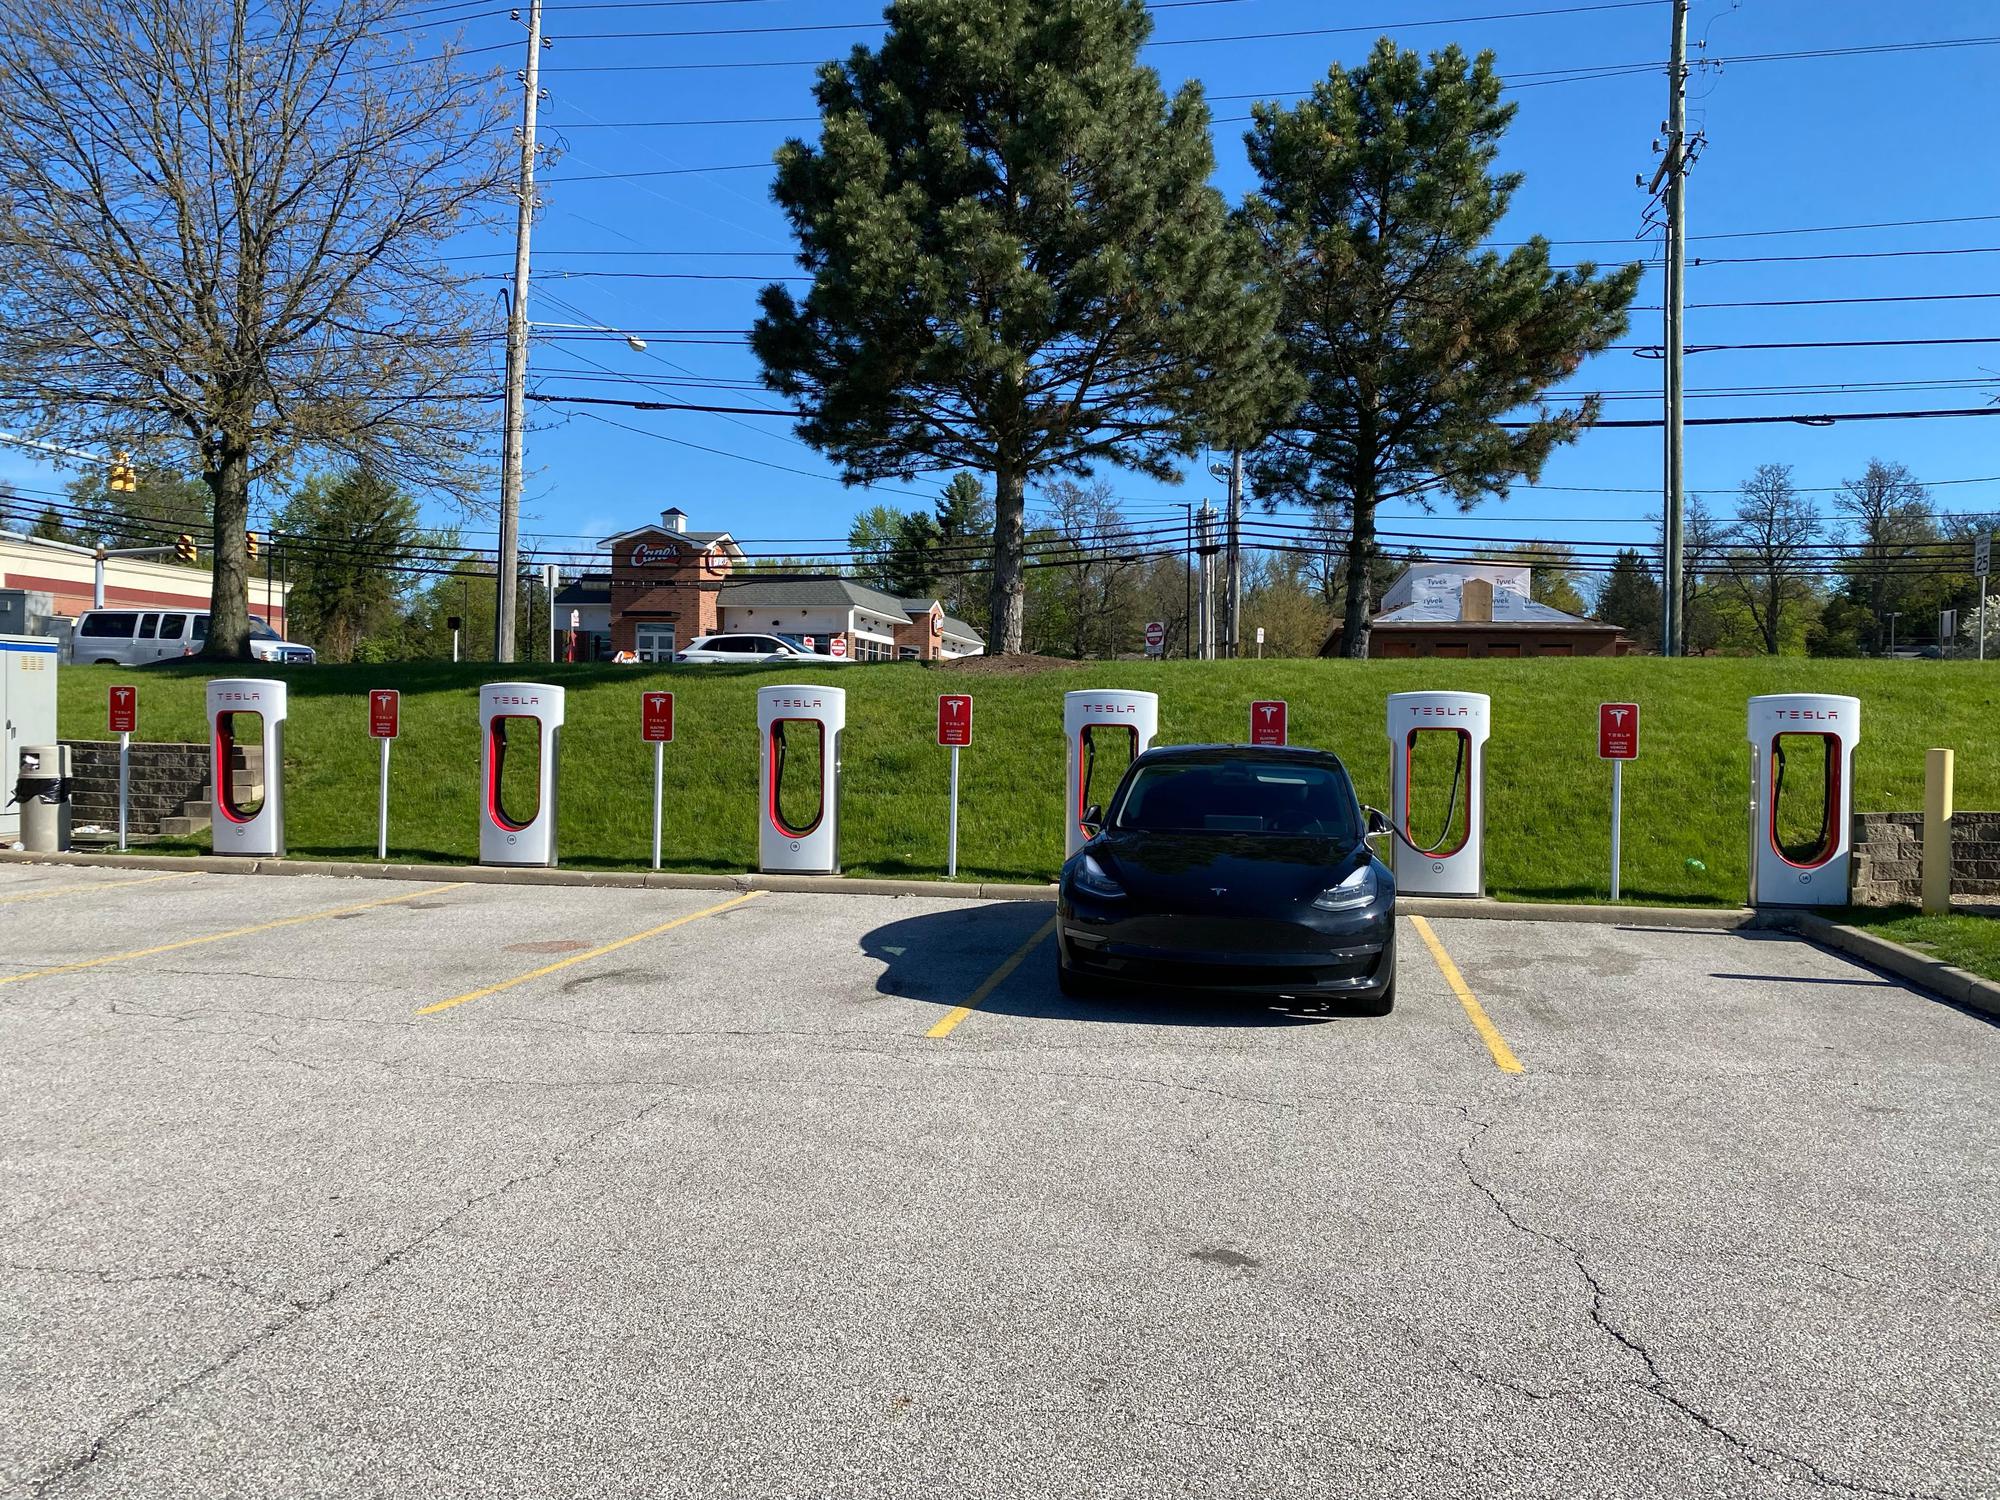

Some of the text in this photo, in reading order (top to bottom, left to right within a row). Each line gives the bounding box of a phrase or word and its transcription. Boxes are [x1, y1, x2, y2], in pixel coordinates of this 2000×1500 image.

[1977, 555, 1988, 572] 25
[217, 692, 260, 701] TESLA
[492, 696, 539, 705] TESLA
[772, 699, 822, 708] TESLA
[1082, 704, 1136, 713] TESLA
[1409, 707, 1468, 716] TESLA
[1775, 710, 1838, 720] TESLA
